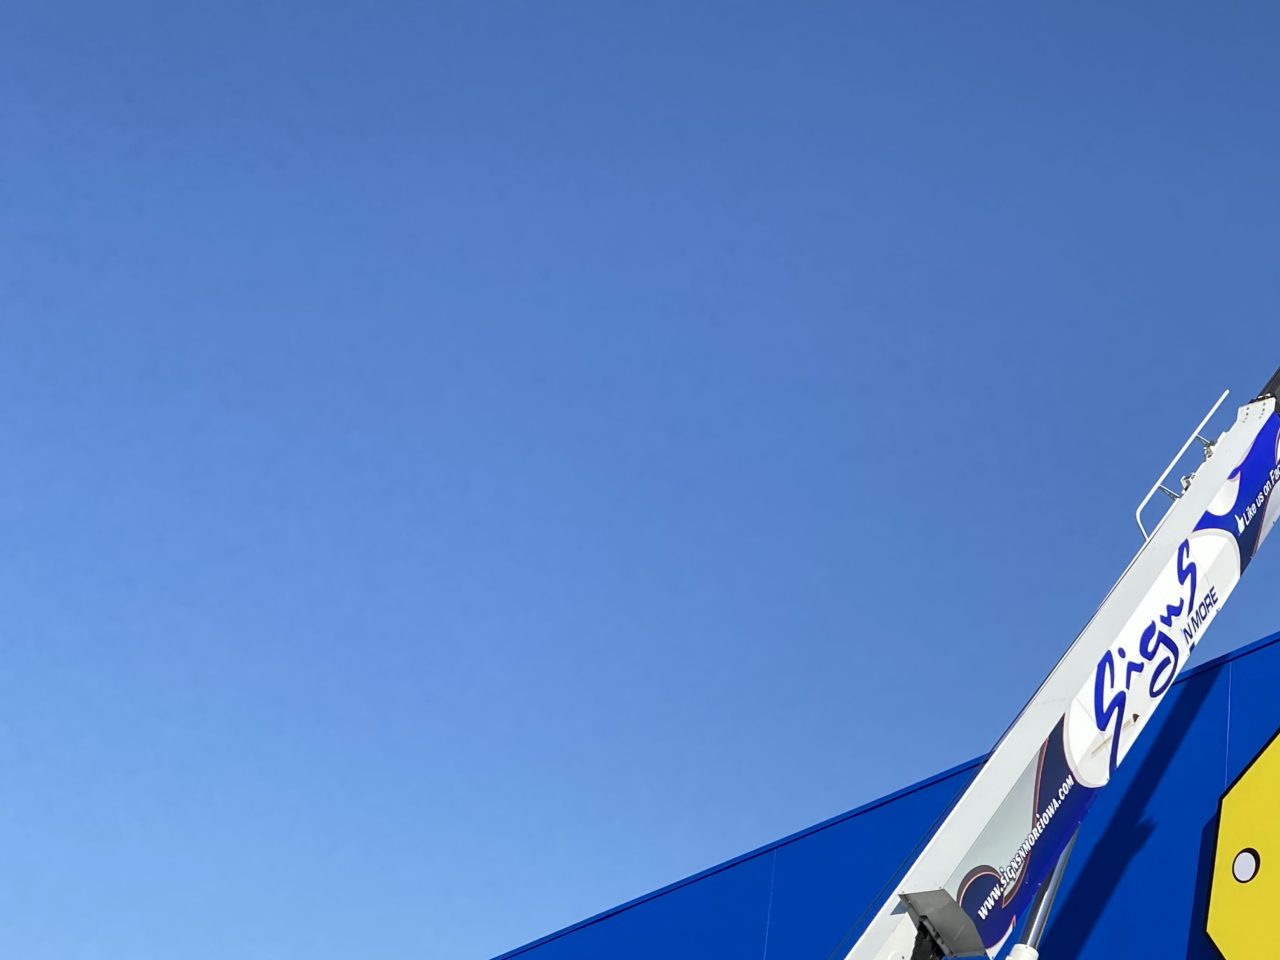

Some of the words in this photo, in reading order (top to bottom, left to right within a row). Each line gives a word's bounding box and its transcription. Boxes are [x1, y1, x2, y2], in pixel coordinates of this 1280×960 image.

[1243, 503, 1257, 525] Like
[1256, 492, 1265, 507] us
[1263, 481, 1271, 496] on
[1190, 586, 1219, 633] MORE
[1094, 538, 1198, 780] Signs
